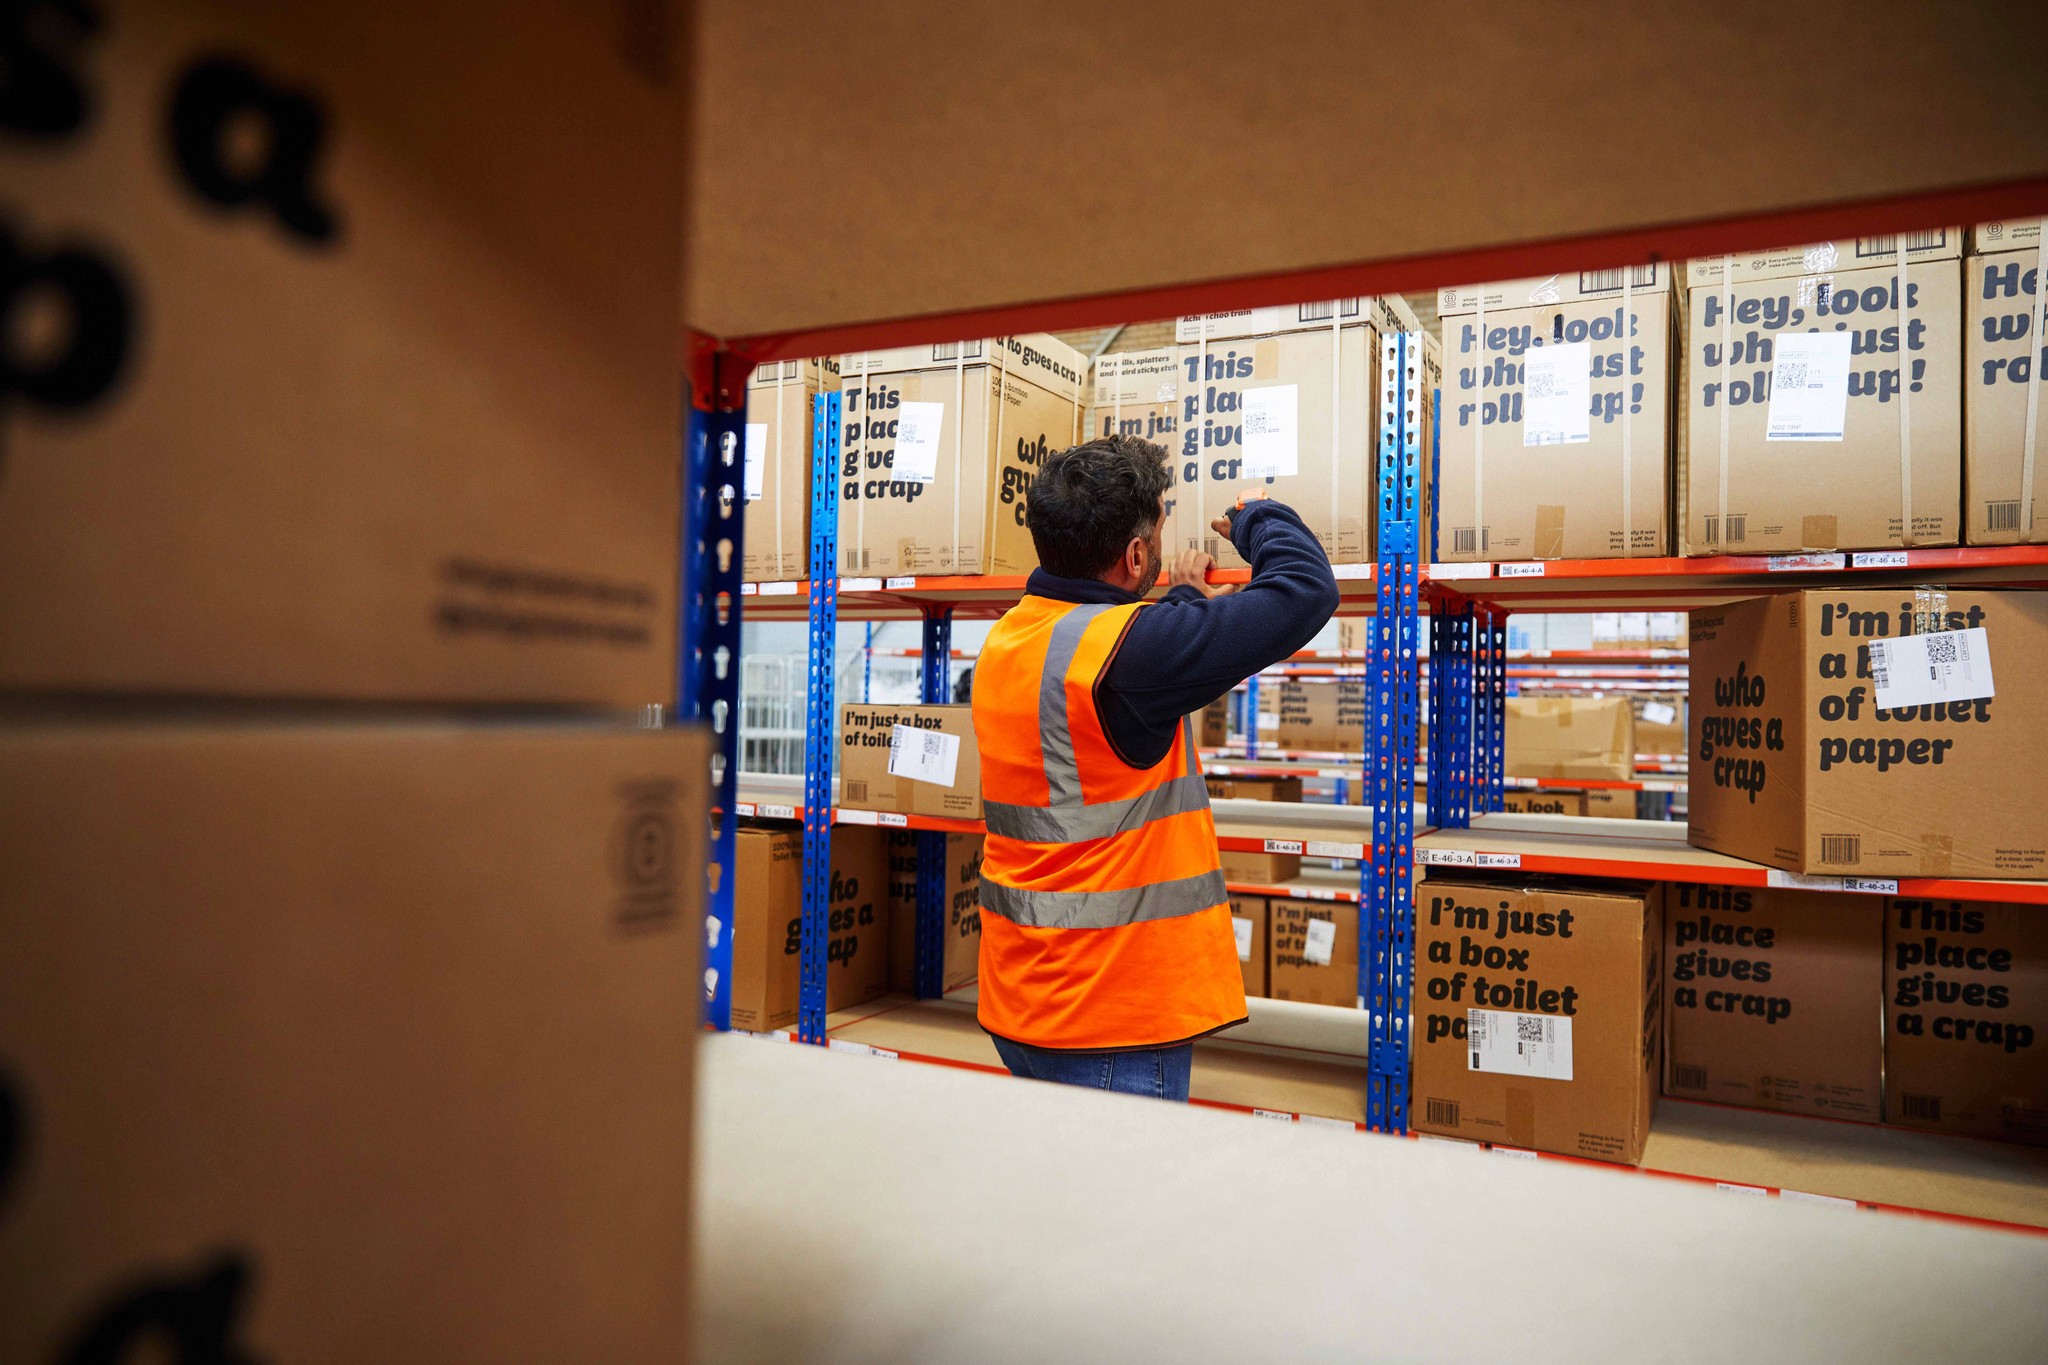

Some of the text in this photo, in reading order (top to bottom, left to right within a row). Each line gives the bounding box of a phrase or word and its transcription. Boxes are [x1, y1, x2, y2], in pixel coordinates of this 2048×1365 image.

[1704, 276, 1918, 329] Hey, look
[1184, 351, 1253, 382] This
[1018, 433, 1057, 467] wh
[844, 481, 859, 500] a
[1819, 653, 1847, 679] a
[1715, 661, 1765, 707] who
[870, 711, 899, 730] just
[914, 713, 942, 729] box
[1819, 686, 1866, 721] of
[845, 731, 860, 746] of
[1700, 715, 1784, 761] gives a
[1820, 737, 1953, 773] paper
[1714, 756, 1765, 804] crap
[1431, 853, 1473, 864] E-46-3-A
[1676, 882, 1752, 913] This
[1859, 883, 1894, 891] E-46-3-C
[858, 903, 874, 926] a
[1495, 901, 1574, 939] just
[1893, 900, 1985, 935] This
[1675, 916, 1775, 949] place
[1428, 936, 1529, 972] a box
[1673, 948, 1771, 983] gives
[1895, 937, 2012, 973] place
[1427, 972, 1578, 1015] of toilet
[1674, 985, 1792, 1025] a crap
[1894, 971, 2010, 1009] gives
[1896, 1012, 2035, 1054] a crap
